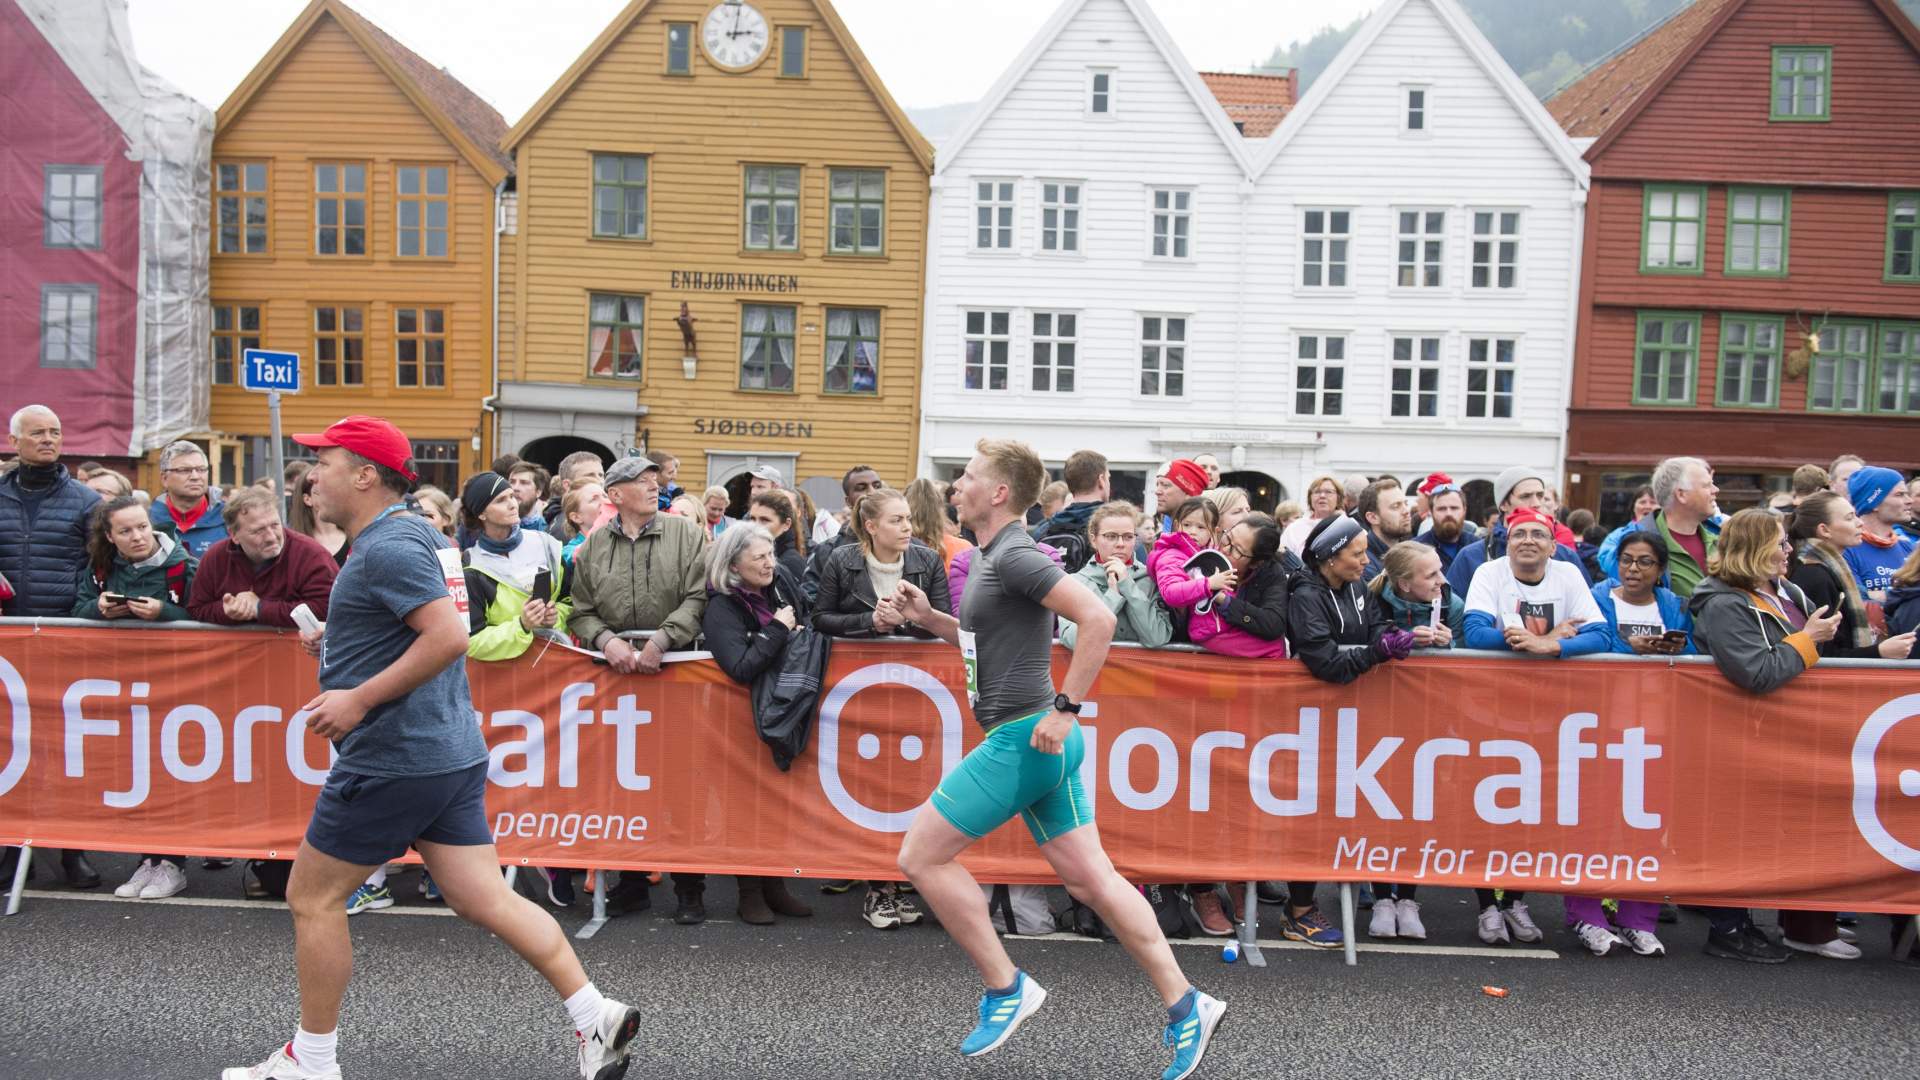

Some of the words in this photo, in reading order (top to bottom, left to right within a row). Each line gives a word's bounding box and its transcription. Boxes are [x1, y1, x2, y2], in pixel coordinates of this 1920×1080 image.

[671, 270, 798, 292] ENHJØRNINGEN
[253, 357, 292, 384] Taxi
[694, 418, 813, 439] SJØBODEN
[1631, 625, 1652, 637] SIM
[1078, 701, 1663, 829] jordkraft
[493, 811, 648, 847] pengene
[1333, 836, 1406, 873] Mer
[1415, 839, 1474, 877] for
[1484, 848, 1660, 886] pengene
